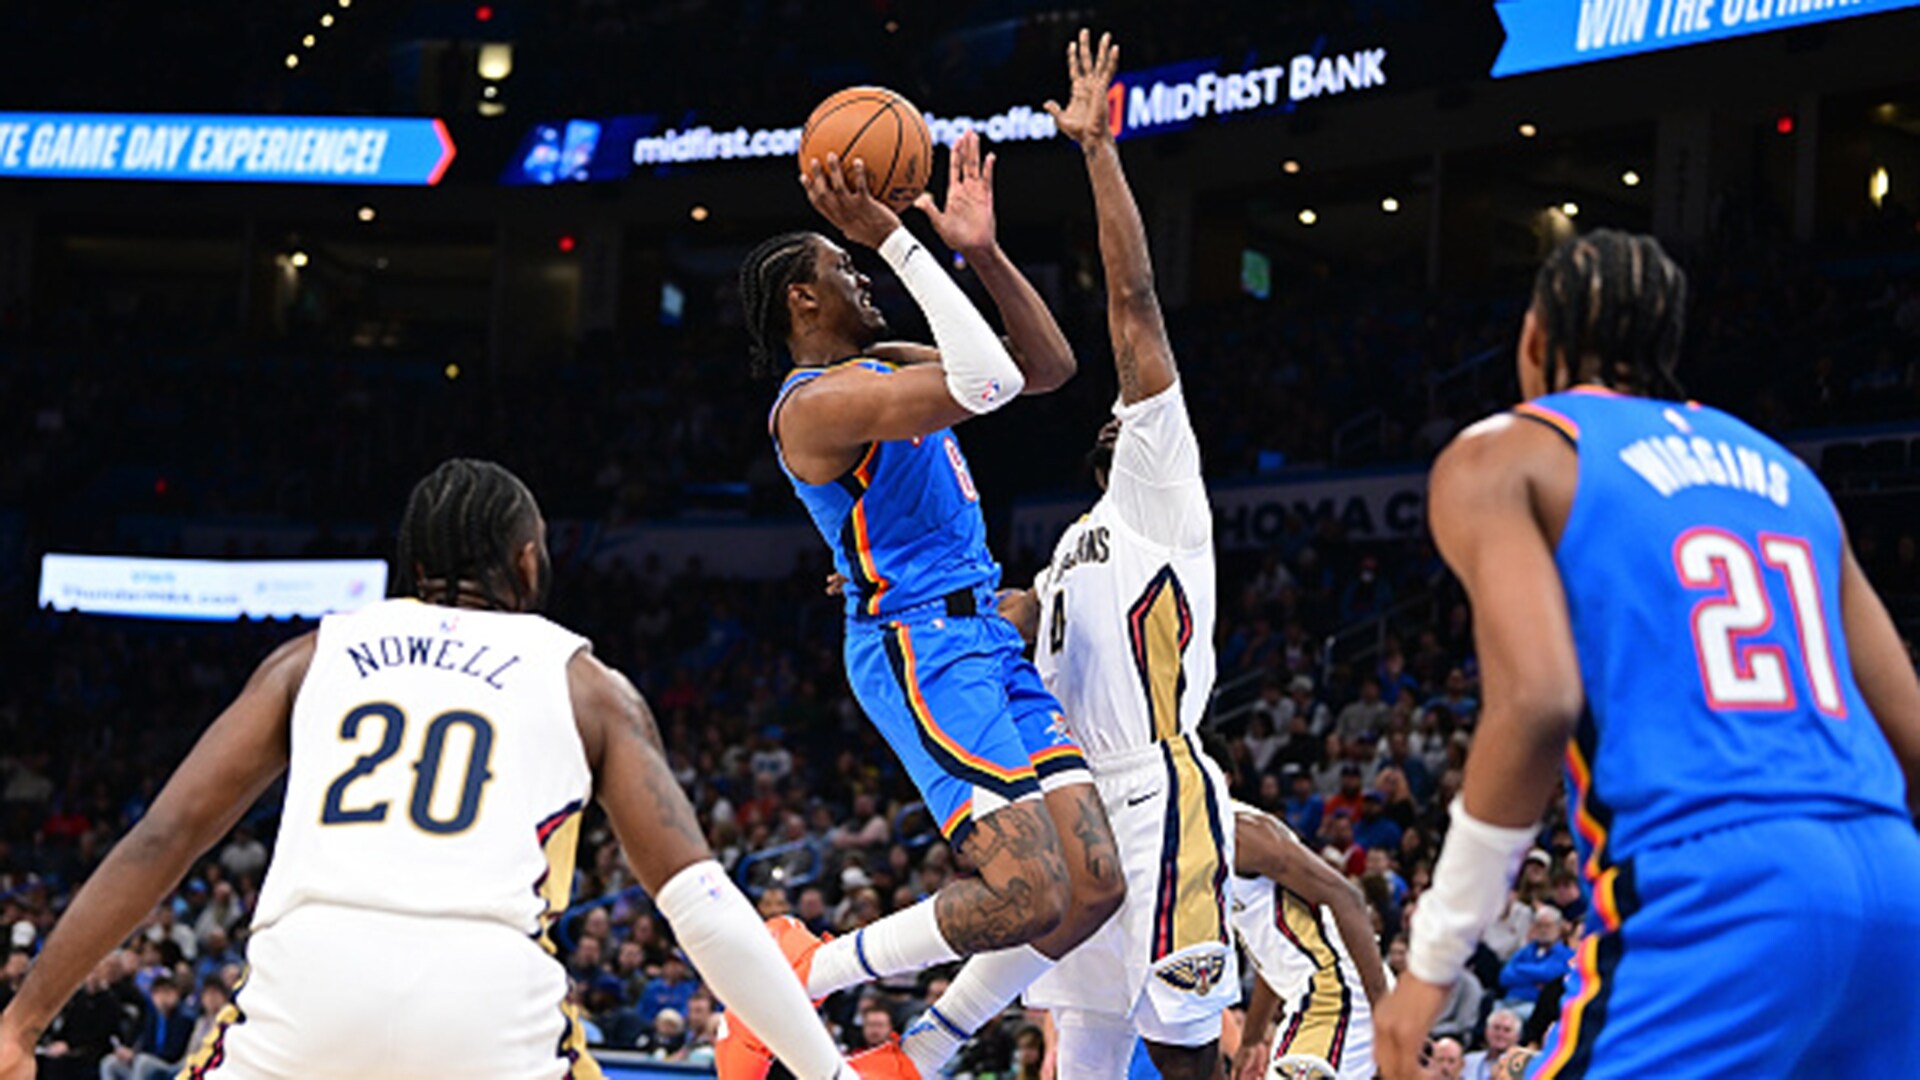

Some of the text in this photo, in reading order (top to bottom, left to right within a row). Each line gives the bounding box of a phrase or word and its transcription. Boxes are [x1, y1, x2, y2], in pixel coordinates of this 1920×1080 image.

[1576, 0, 1650, 51] WIN
[1289, 47, 1387, 100] BANK
[26, 123, 126, 170] GAME
[121, 124, 192, 171] DAY
[187, 125, 389, 175] EXPERIENCE!
[1618, 434, 1790, 508] WIGGINS
[1671, 524, 1848, 720] 21
[346, 634, 521, 691] NOWELL
[318, 699, 497, 837] 20
